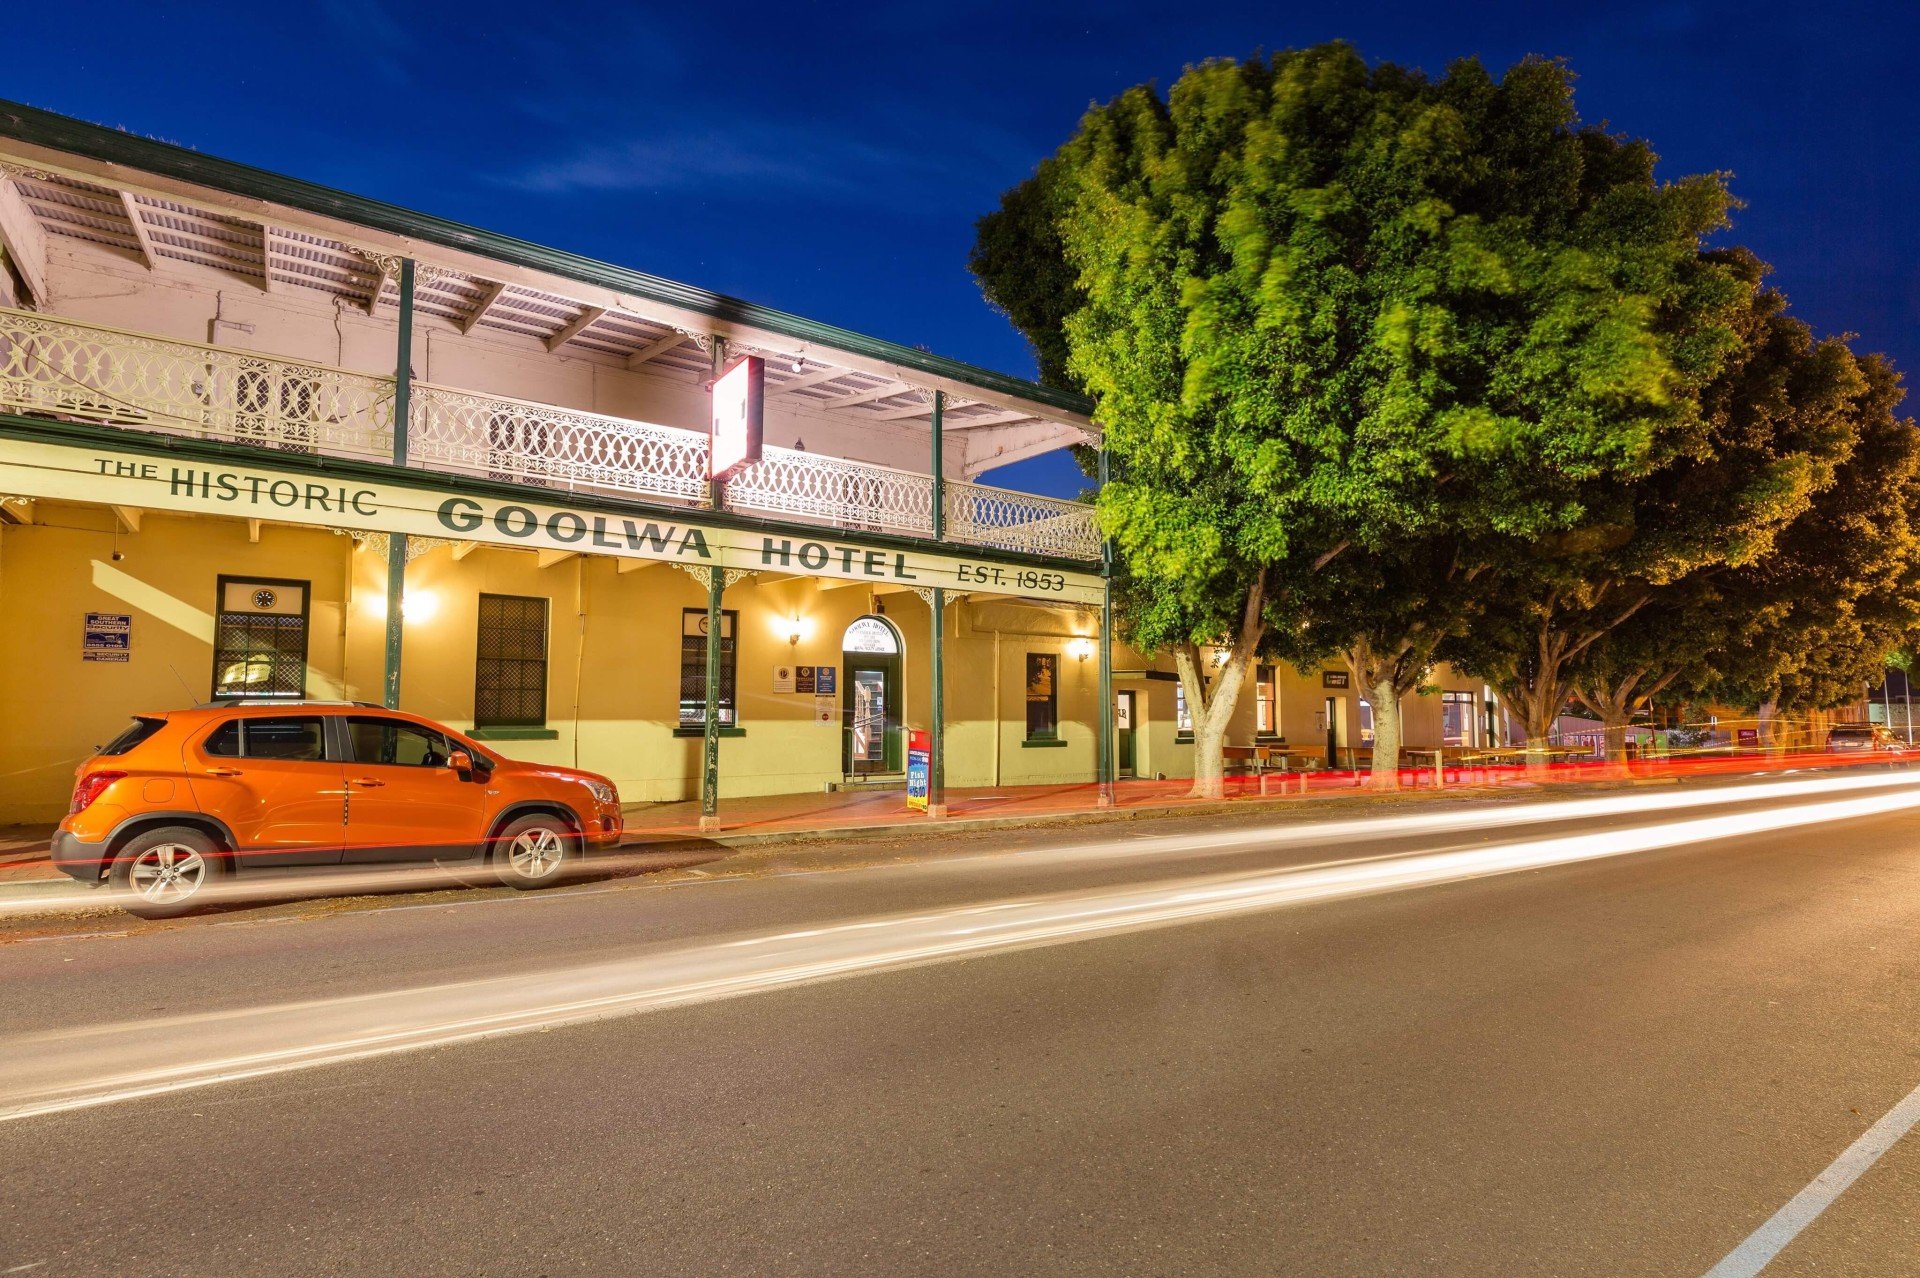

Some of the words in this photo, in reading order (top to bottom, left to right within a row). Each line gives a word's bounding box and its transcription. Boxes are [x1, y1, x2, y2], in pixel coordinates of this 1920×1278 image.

[95, 459, 158, 479] THE
[170, 467, 378, 517] HISTORIC
[437, 497, 712, 559] GOOLWA
[761, 537, 917, 580] HOTEL
[957, 564, 1007, 587] EST.
[1017, 571, 1065, 592] 1853
[910, 771, 925, 779] Fish
[909, 779, 927, 788] Night
